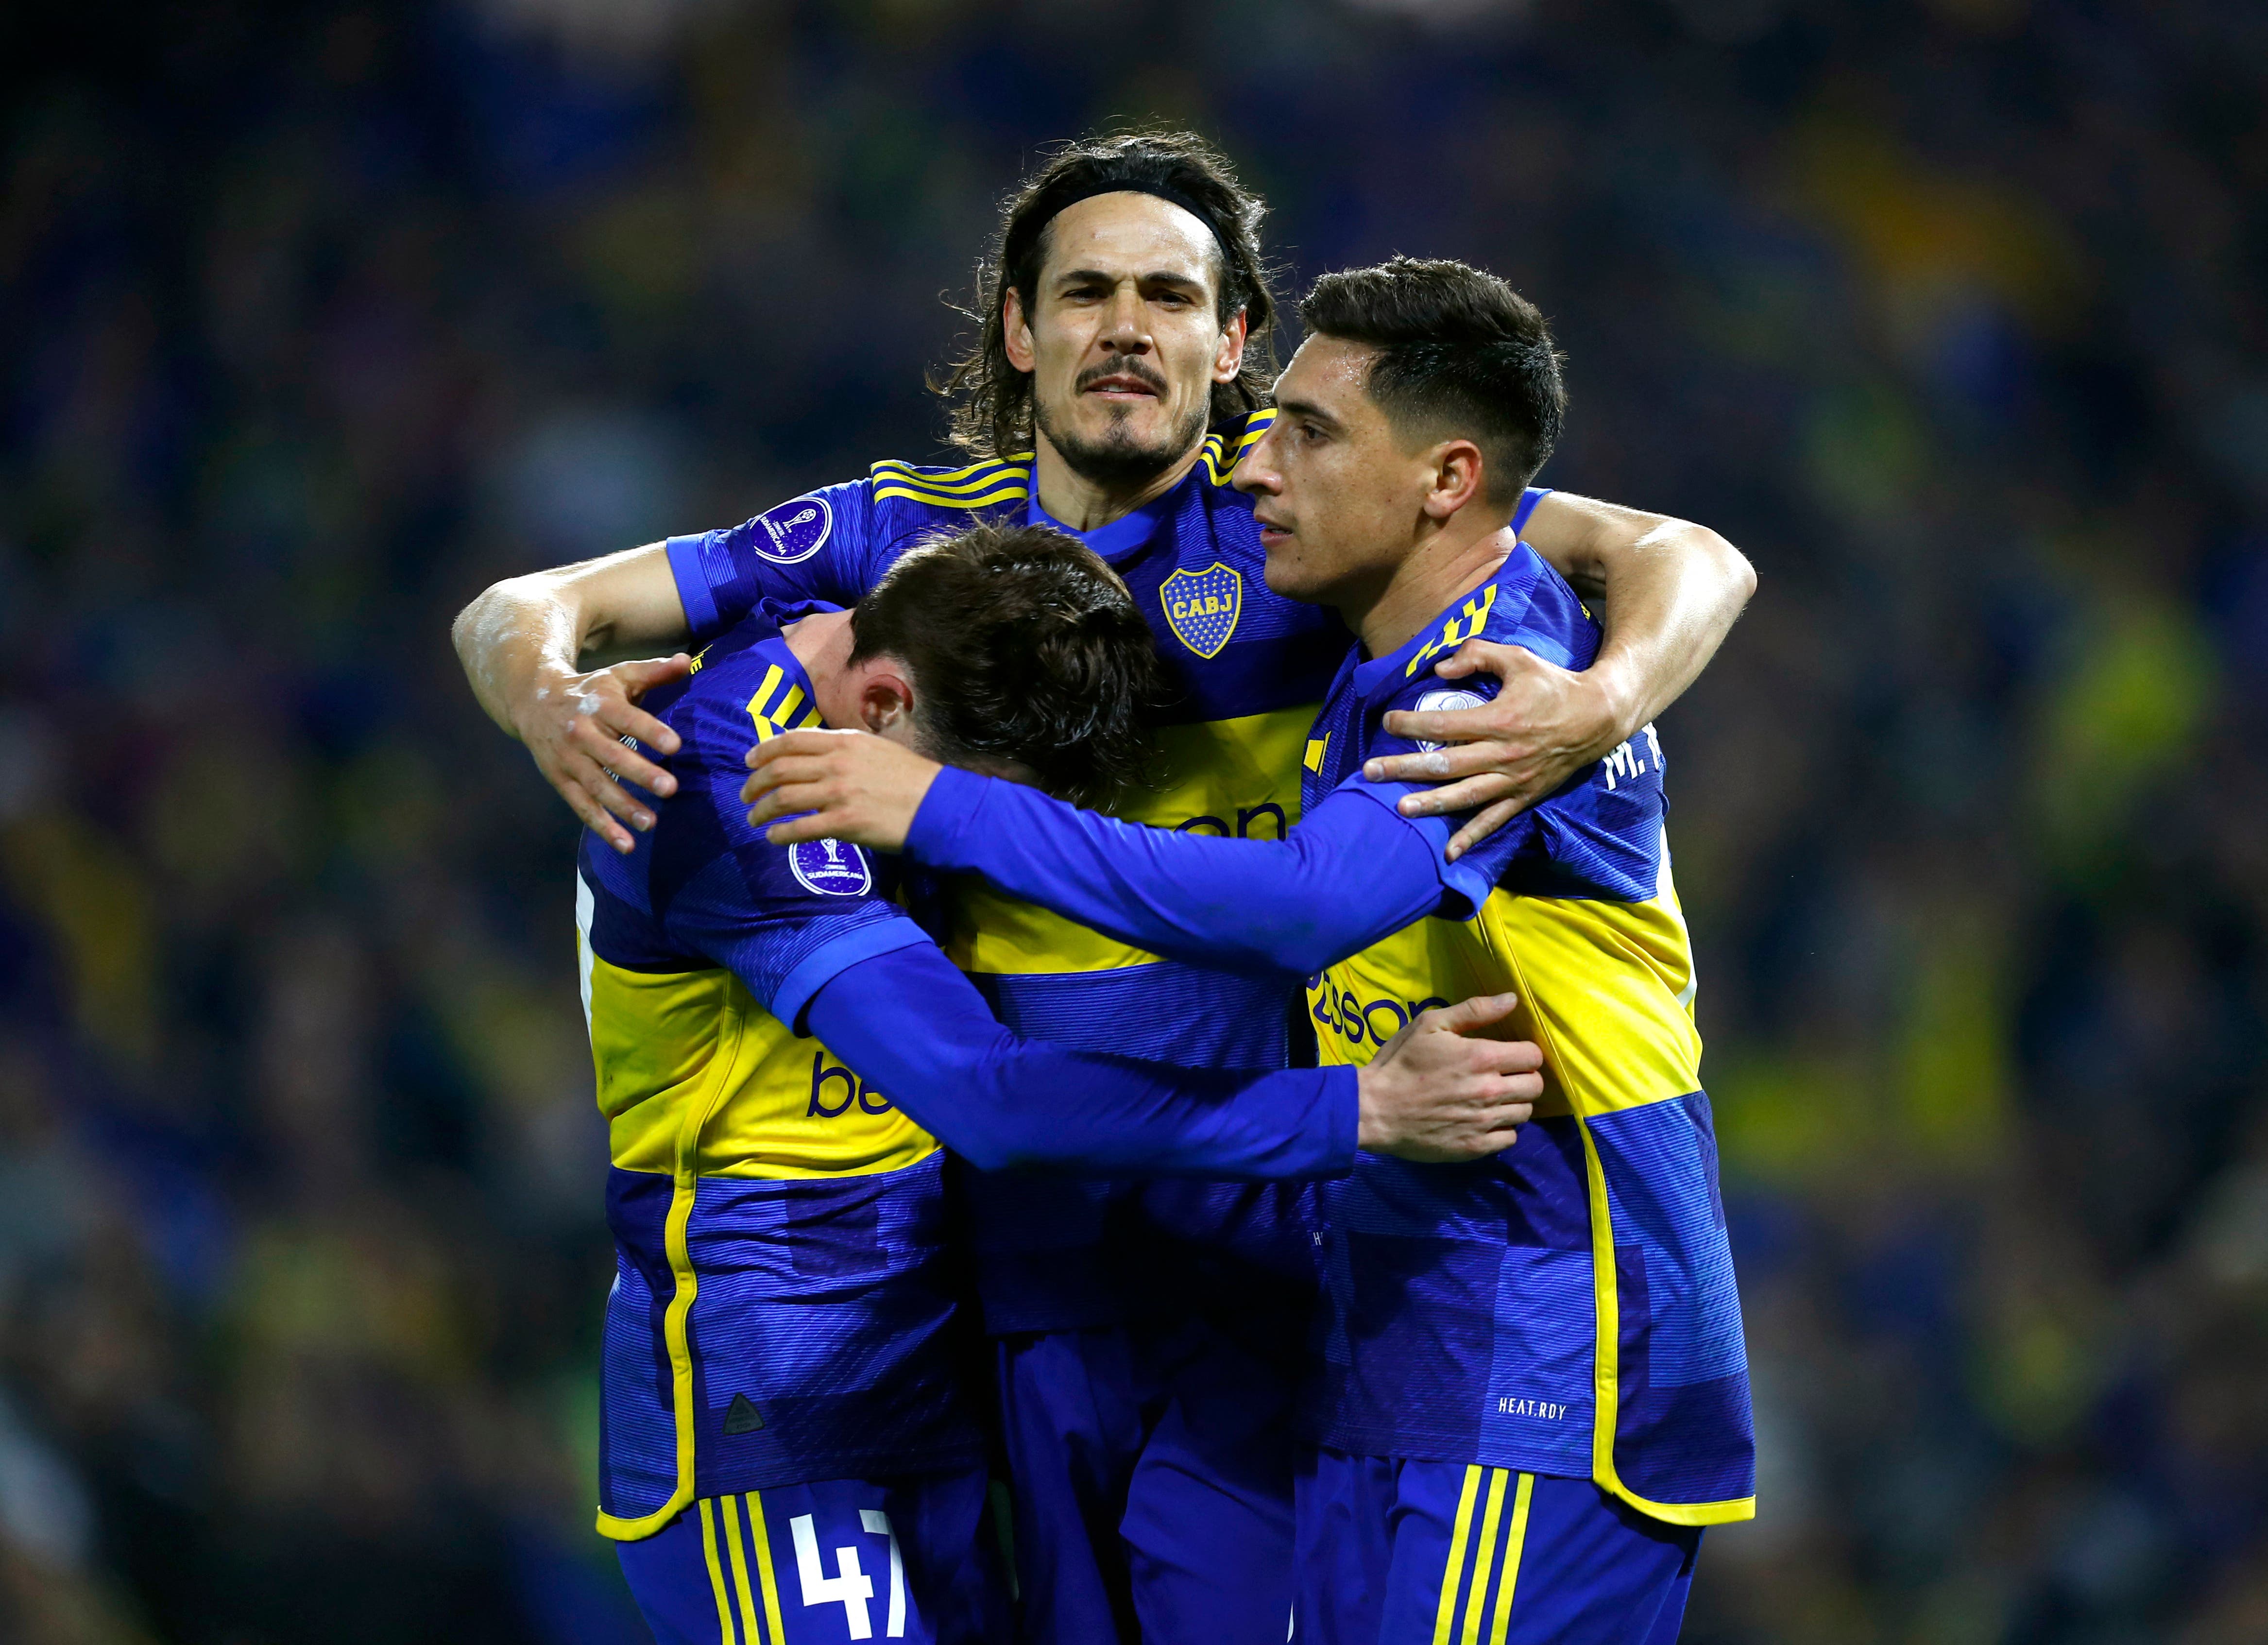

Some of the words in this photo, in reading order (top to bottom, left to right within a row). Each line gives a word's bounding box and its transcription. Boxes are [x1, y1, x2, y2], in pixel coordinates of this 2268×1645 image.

[760, 516, 787, 556] SUDAMERICANA
[1173, 594, 1232, 619] CABJ
[806, 870, 865, 880] SUDAMERICANA
[1499, 1397, 1567, 1421] HEAT.RDY
[789, 1509, 906, 1641] 47
